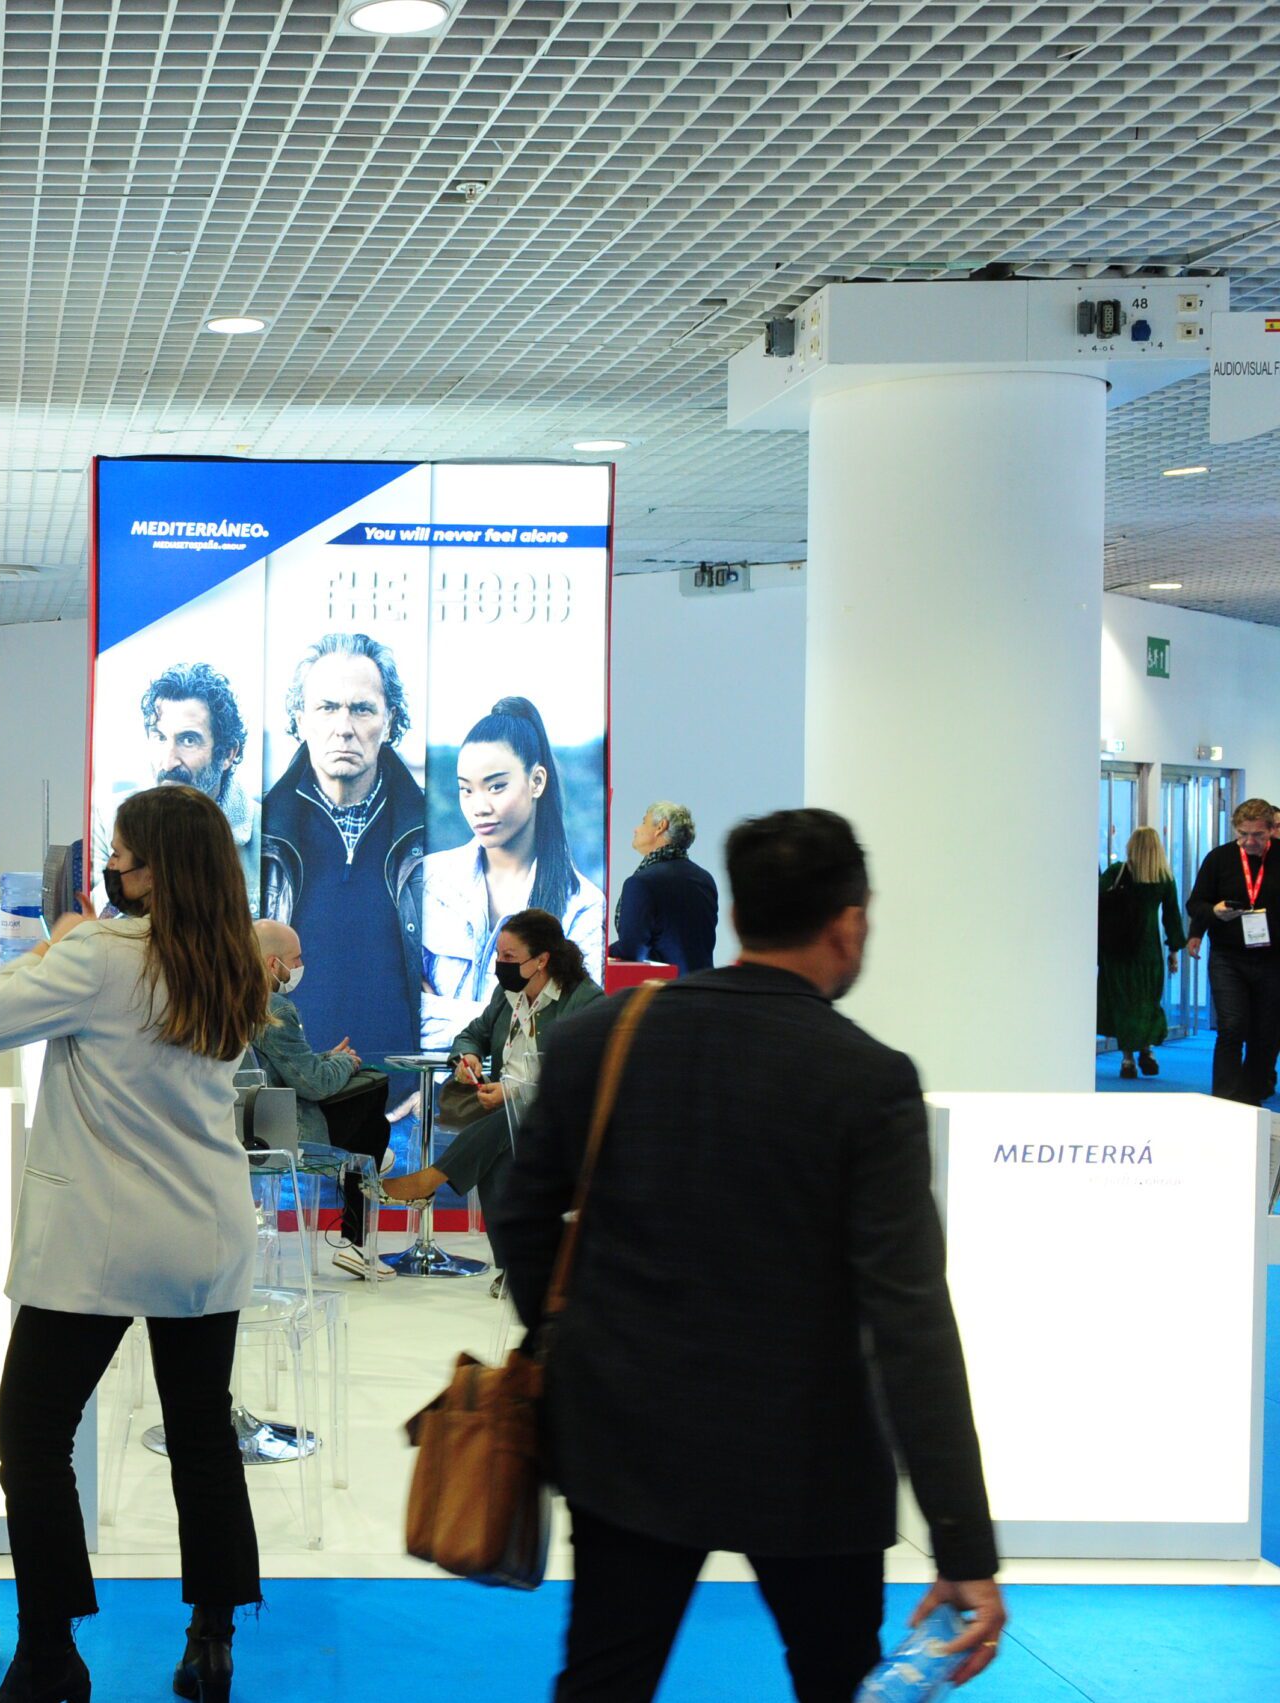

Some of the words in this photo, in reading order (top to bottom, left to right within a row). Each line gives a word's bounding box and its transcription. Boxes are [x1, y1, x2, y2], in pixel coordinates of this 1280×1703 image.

[1132, 298, 1148, 309] 48
[1213, 361, 1273, 376] AUDIOVISUAL
[364, 526, 396, 540] You
[399, 526, 431, 541] will
[433, 530, 482, 542] never
[484, 528, 518, 543] feel
[519, 528, 568, 543] alone
[432, 572, 571, 624] HOOD
